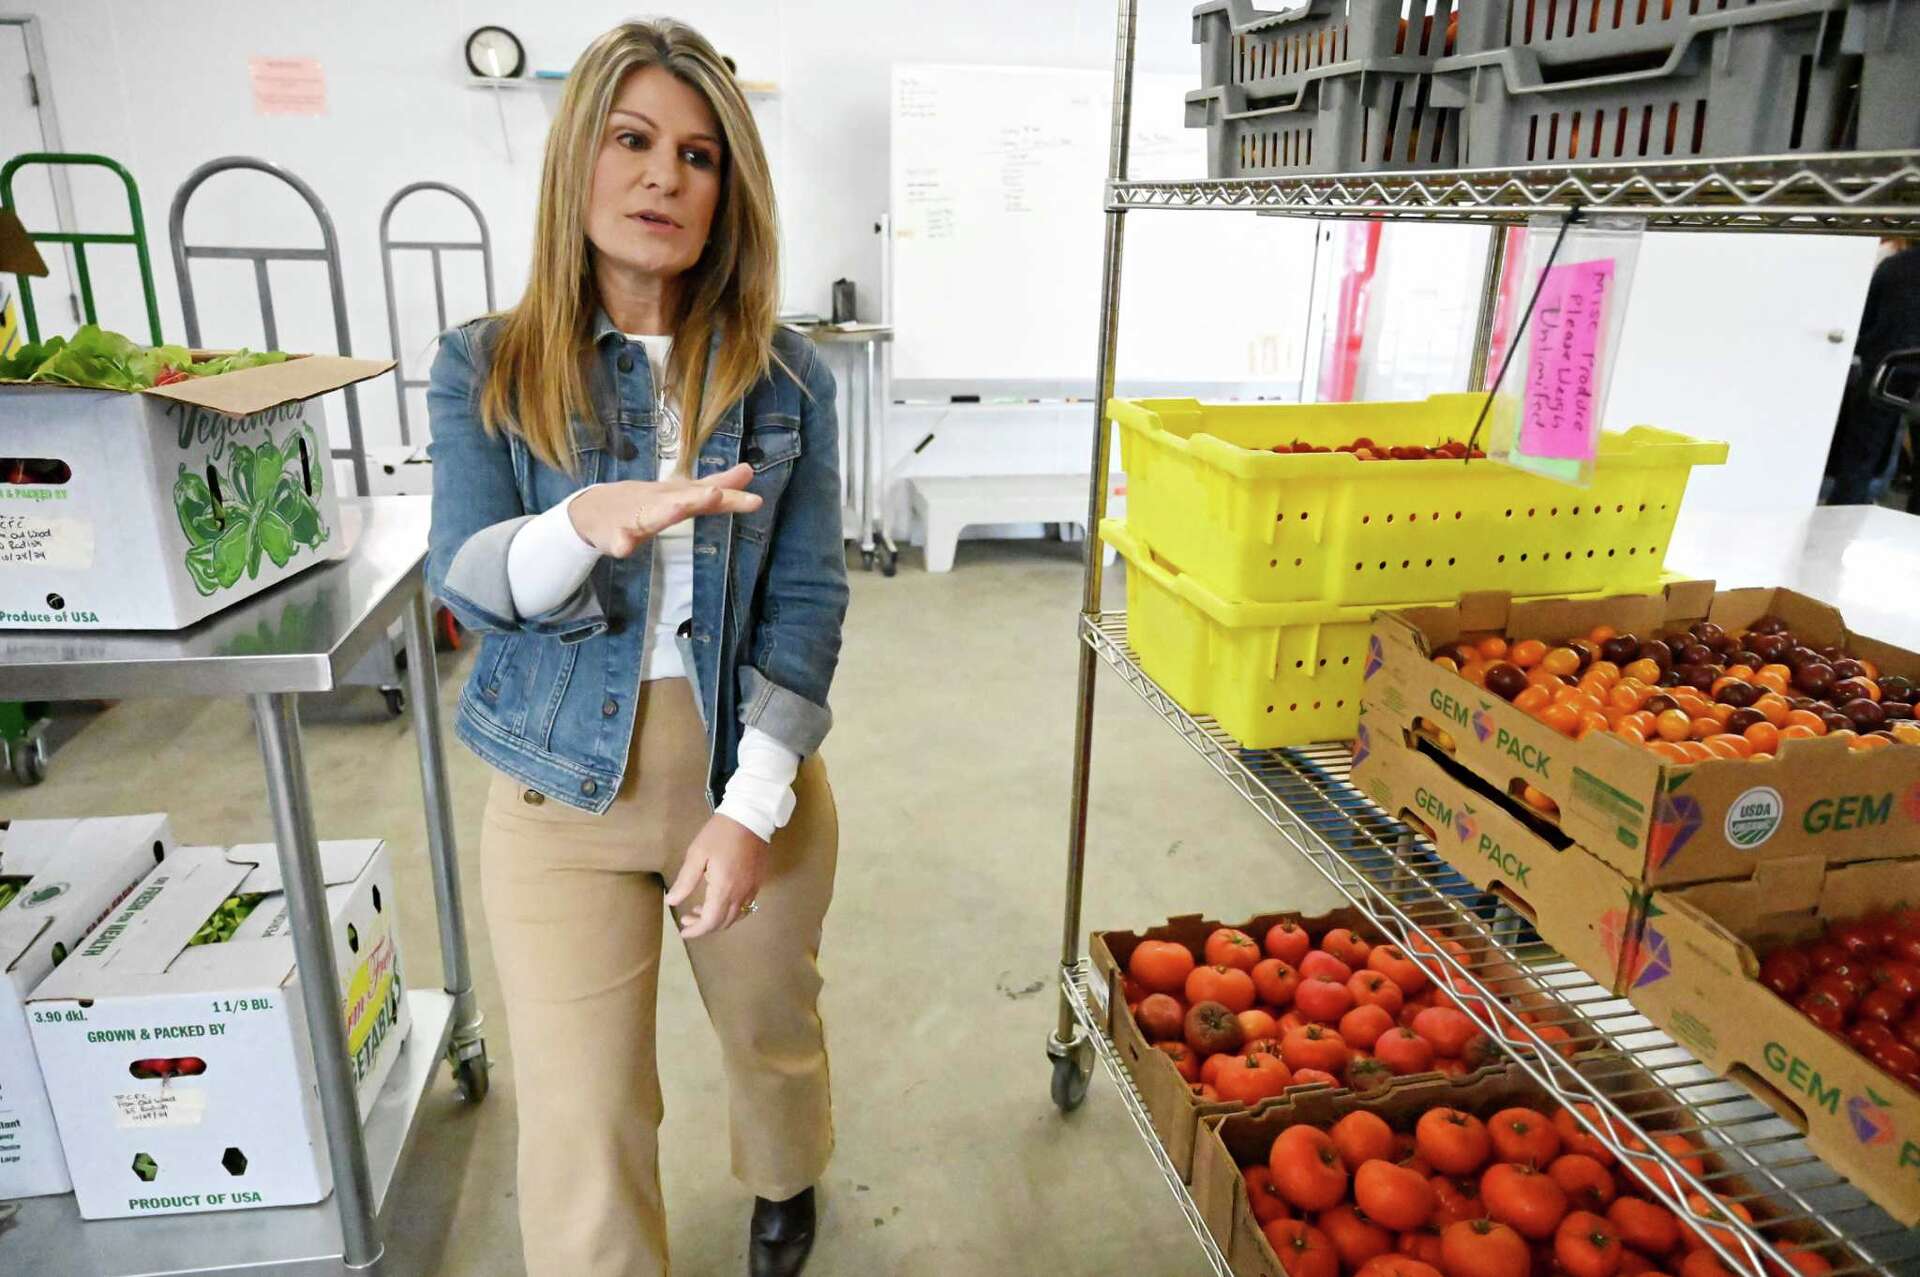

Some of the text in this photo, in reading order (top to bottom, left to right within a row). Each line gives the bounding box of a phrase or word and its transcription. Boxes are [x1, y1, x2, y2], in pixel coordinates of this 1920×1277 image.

[1532, 306, 1560, 428] Unlimited
[1551, 294, 1583, 429] Please Weigh
[1573, 352, 1594, 432] Produce
[0, 611, 99, 623] Produce of USA
[1430, 688, 1469, 727] GEM
[1497, 728, 1550, 779] PACK
[1740, 803, 1771, 818] USDA
[1803, 792, 1894, 834] GEM
[1415, 788, 1453, 829] GEM
[1479, 834, 1531, 888] PACK
[81, 925, 127, 956] HEALTH
[34, 1009, 88, 1023] 3.90 dkl.
[213, 998, 273, 1015] 1 1/9 BU.
[87, 1023, 226, 1043] GROWN & PACKED BY
[1764, 1042, 1841, 1115] GEM
[129, 1191, 262, 1210] PRODUCT OF USA
